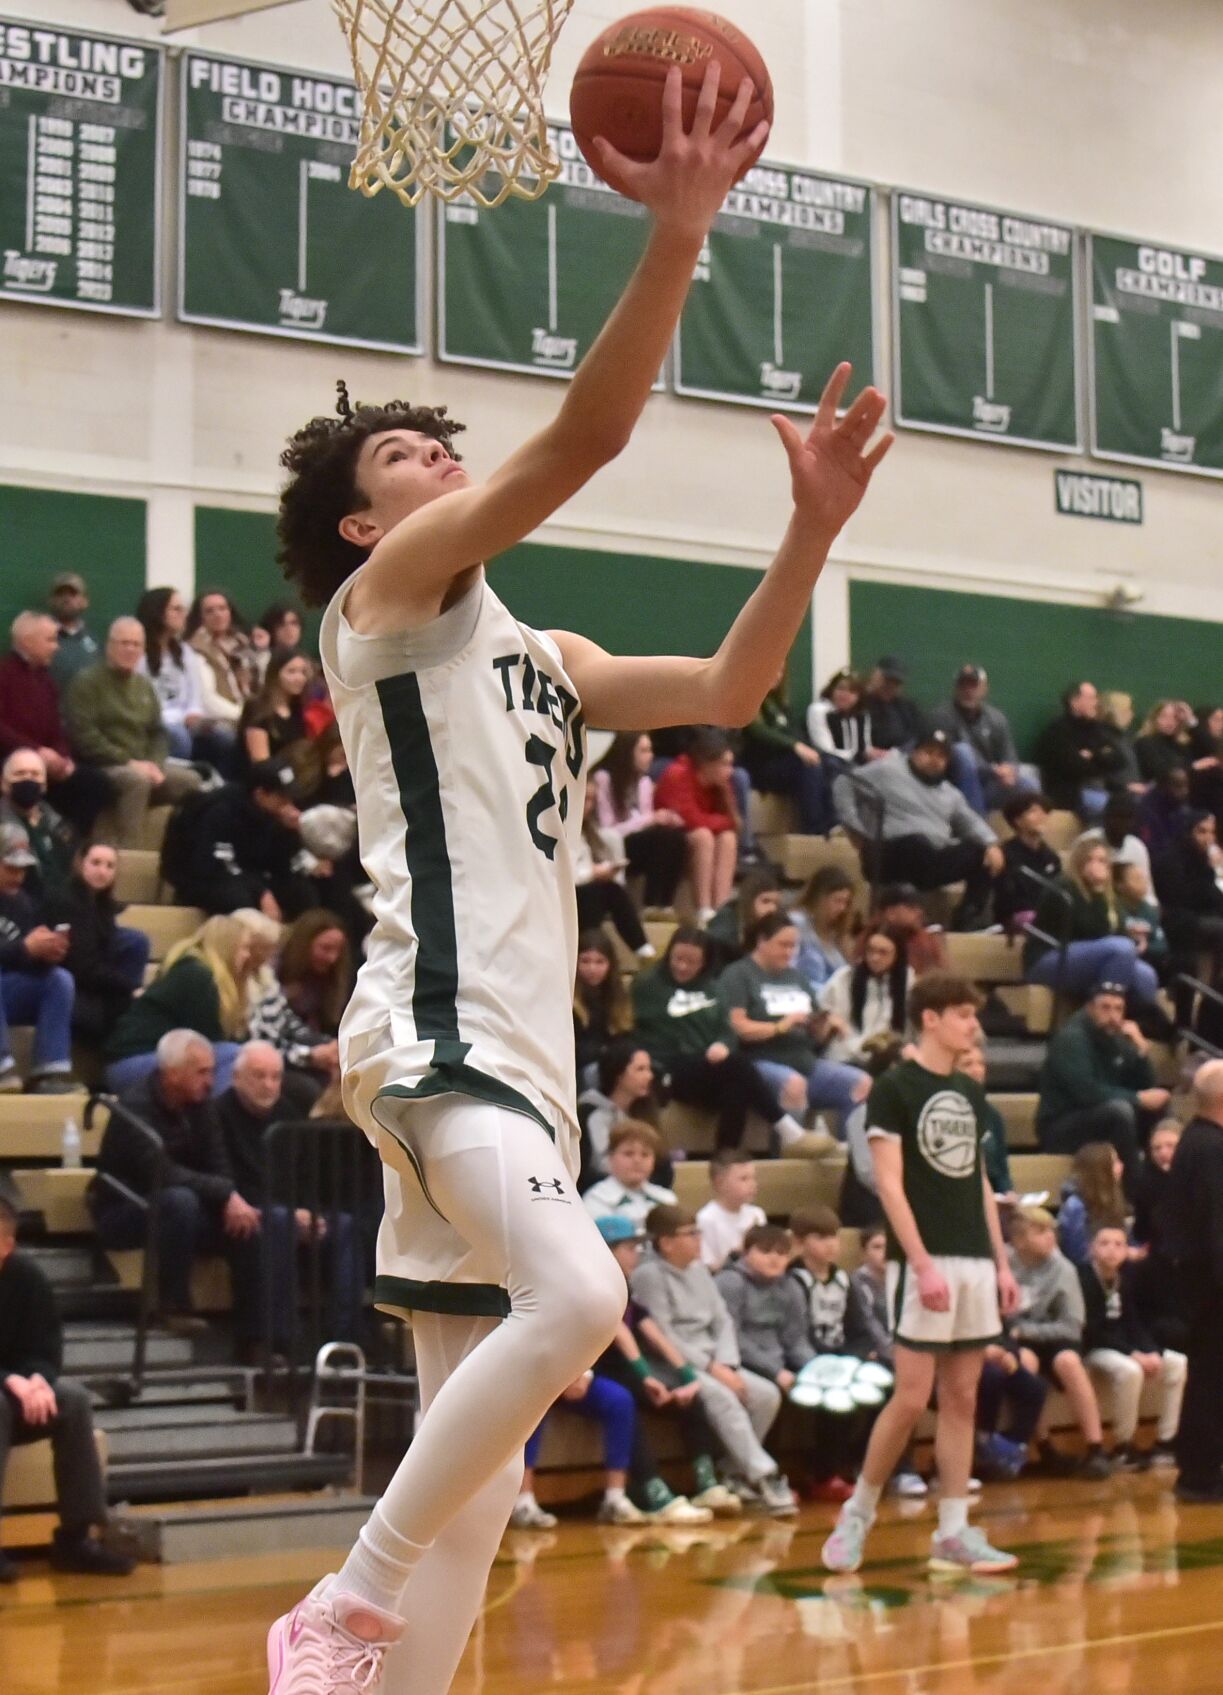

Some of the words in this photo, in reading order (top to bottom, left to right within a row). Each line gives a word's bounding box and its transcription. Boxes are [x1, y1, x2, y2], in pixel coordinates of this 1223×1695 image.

[190, 59, 280, 102] FIELD
[226, 99, 359, 143] CHAMPION
[900, 196, 946, 229] GIRLS
[950, 206, 999, 241] CROSS
[1002, 217, 1070, 256] COUNTRY
[1138, 246, 1206, 281] GOLF
[1057, 475, 1140, 518] VISITOR
